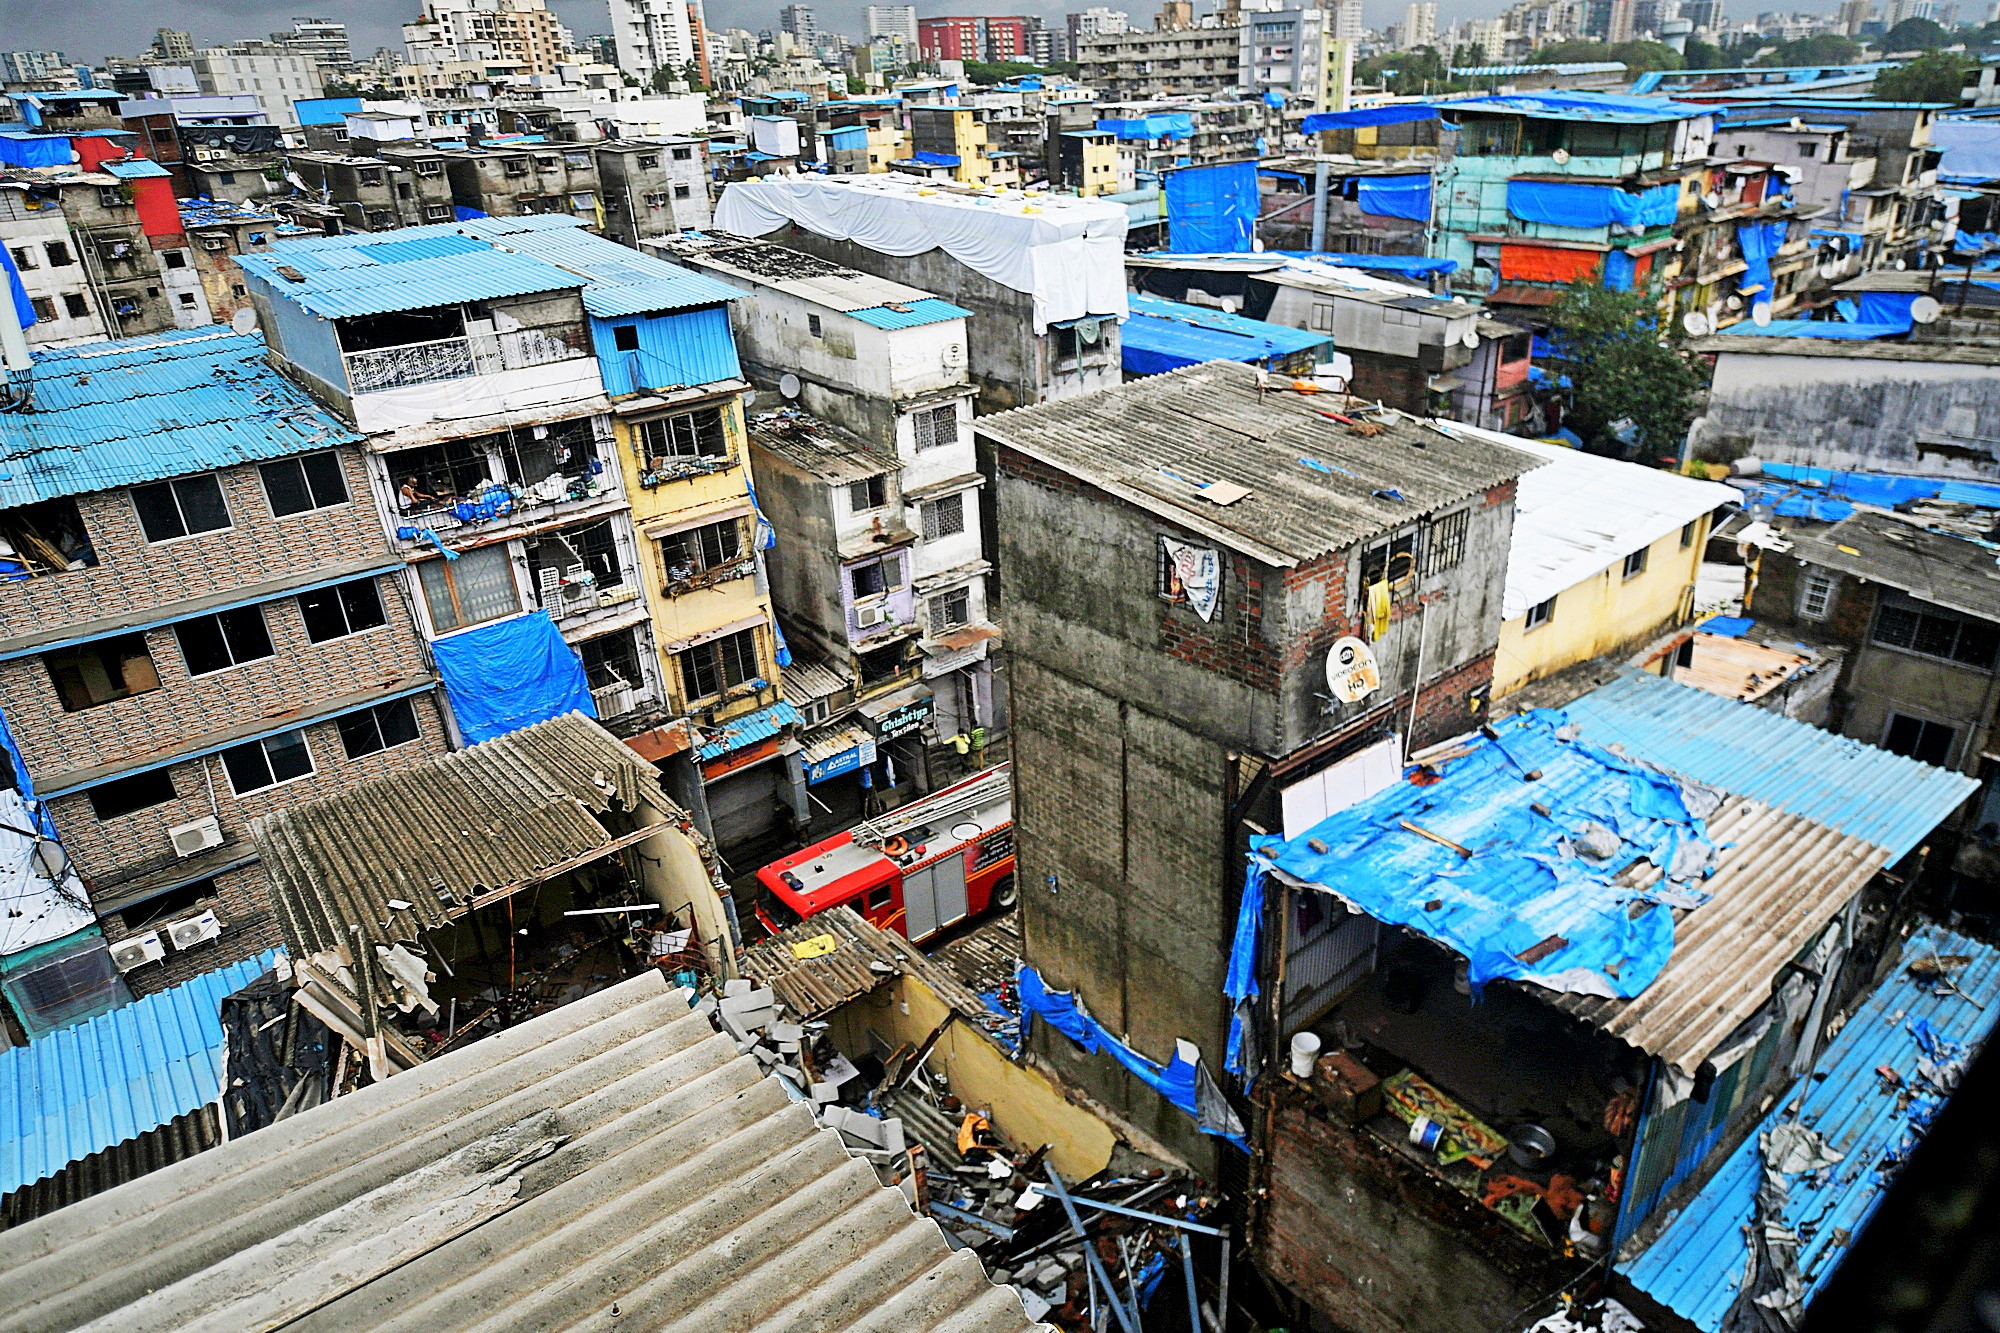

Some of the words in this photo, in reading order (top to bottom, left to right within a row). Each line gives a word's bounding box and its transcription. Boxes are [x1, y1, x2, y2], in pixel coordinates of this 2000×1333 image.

[1331, 659, 1372, 681] VIDEOCON
[1348, 678, 1364, 692] HD
[834, 752, 857, 765] ASTRAL
